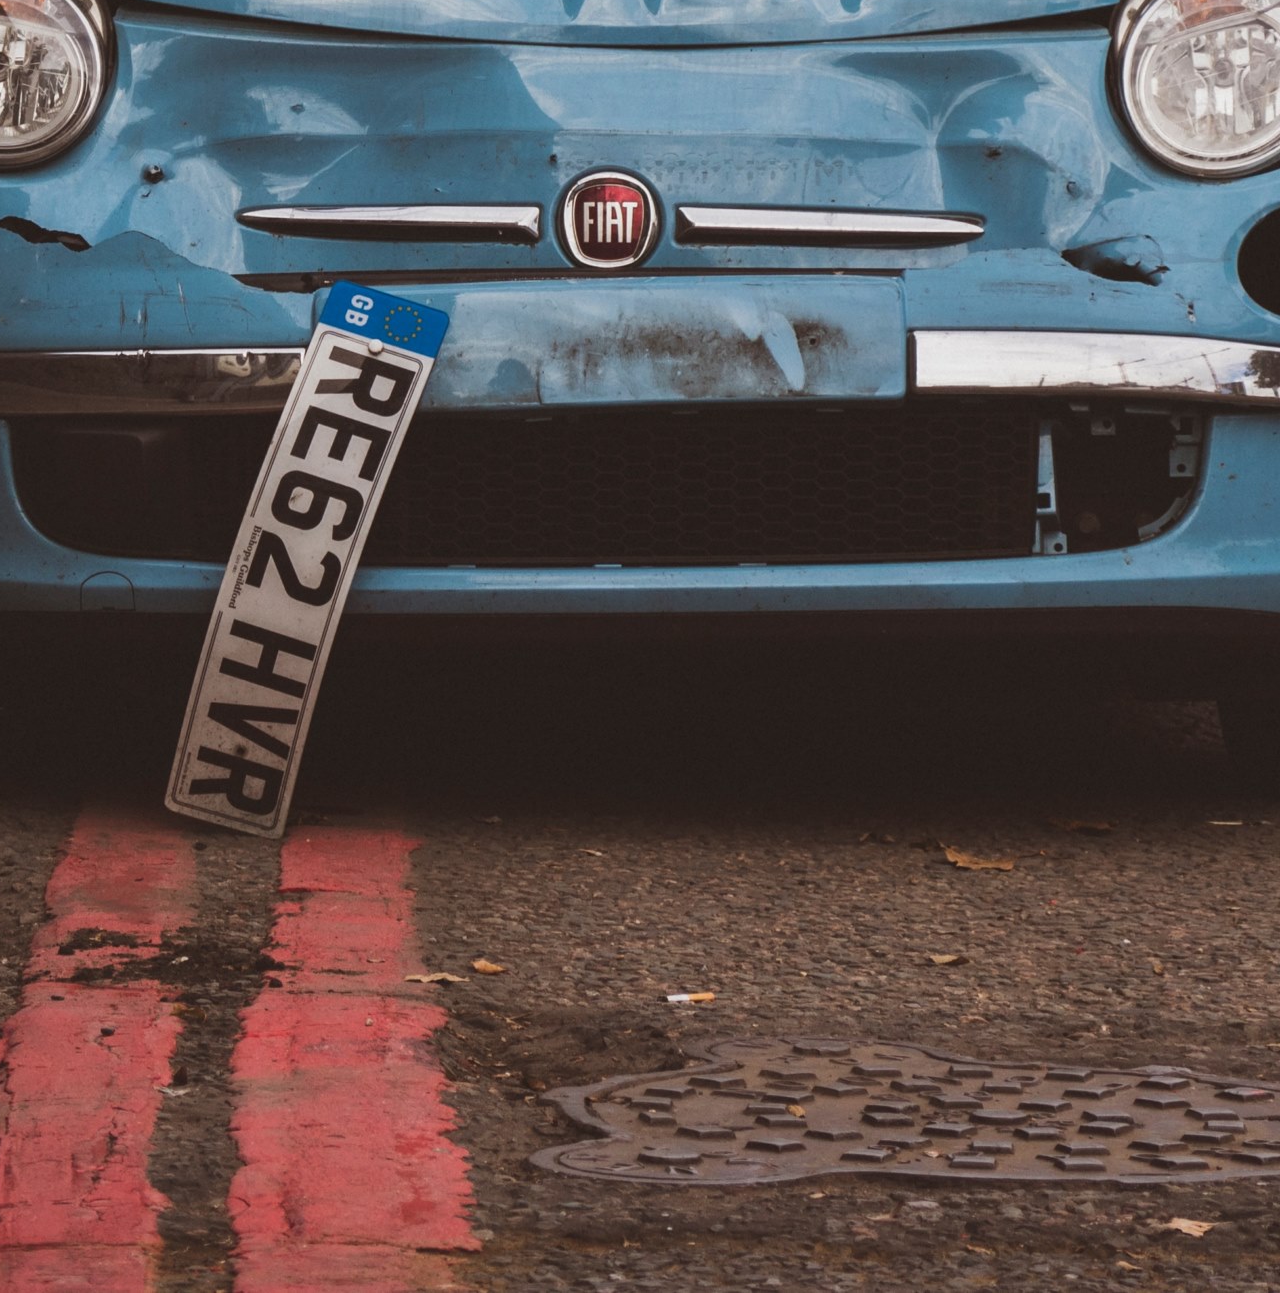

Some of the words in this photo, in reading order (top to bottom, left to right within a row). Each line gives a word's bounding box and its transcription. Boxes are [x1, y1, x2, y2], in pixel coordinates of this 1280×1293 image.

[583, 201, 638, 243] FIAT
[345, 293, 374, 328] GB
[245, 345, 416, 608] RE62
[243, 525, 262, 562] Bishops
[228, 564, 249, 609] Guildford
[188, 618, 318, 817] HVR
